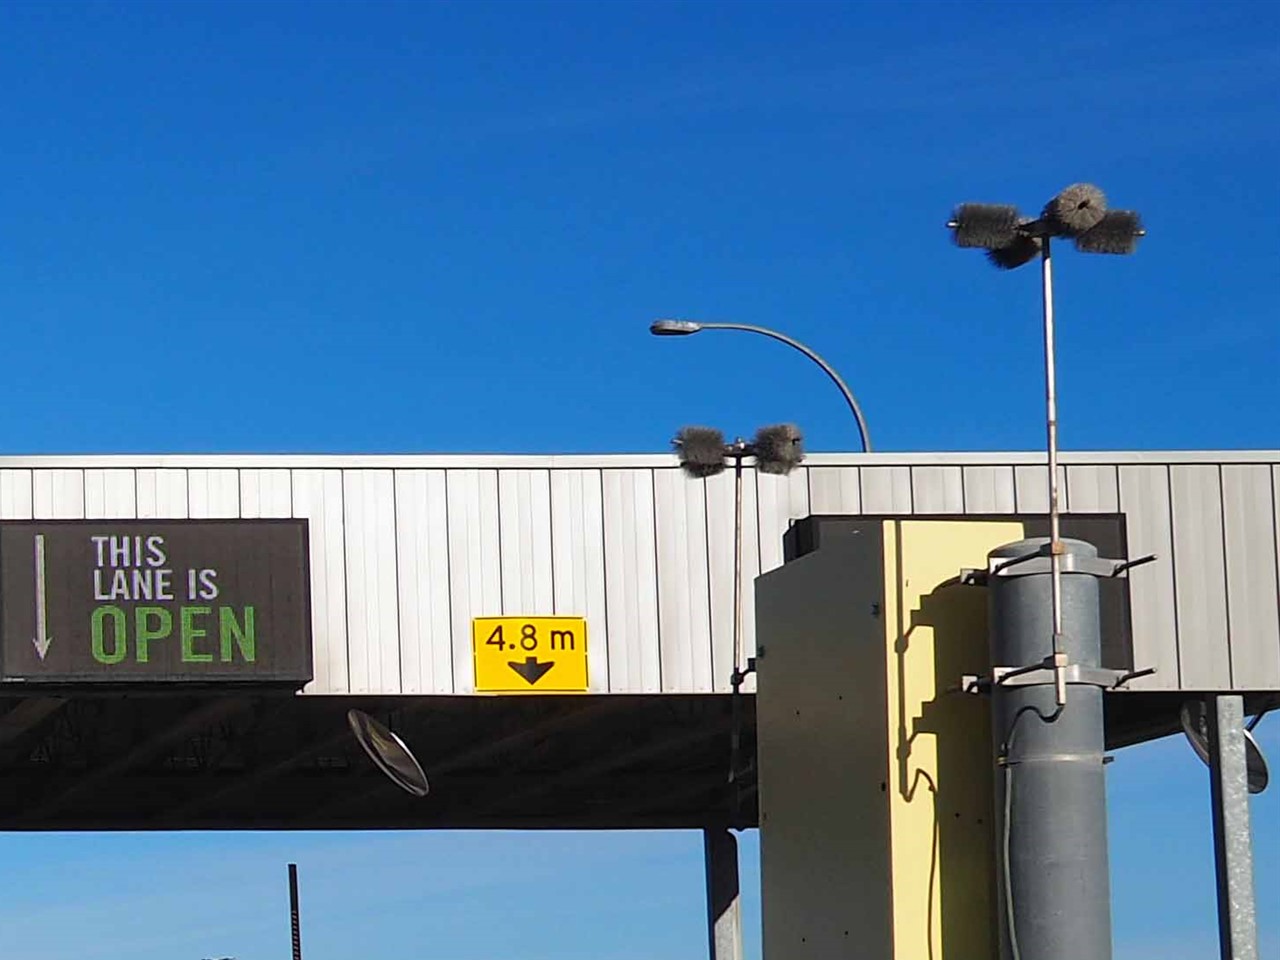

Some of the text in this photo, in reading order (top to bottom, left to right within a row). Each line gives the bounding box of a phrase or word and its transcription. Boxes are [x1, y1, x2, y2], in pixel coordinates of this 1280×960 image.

[91, 536, 165, 568] THIS
[93, 568, 219, 600] LANE IS
[90, 605, 256, 664] OPEN
[485, 625, 576, 652] 4.8 m
